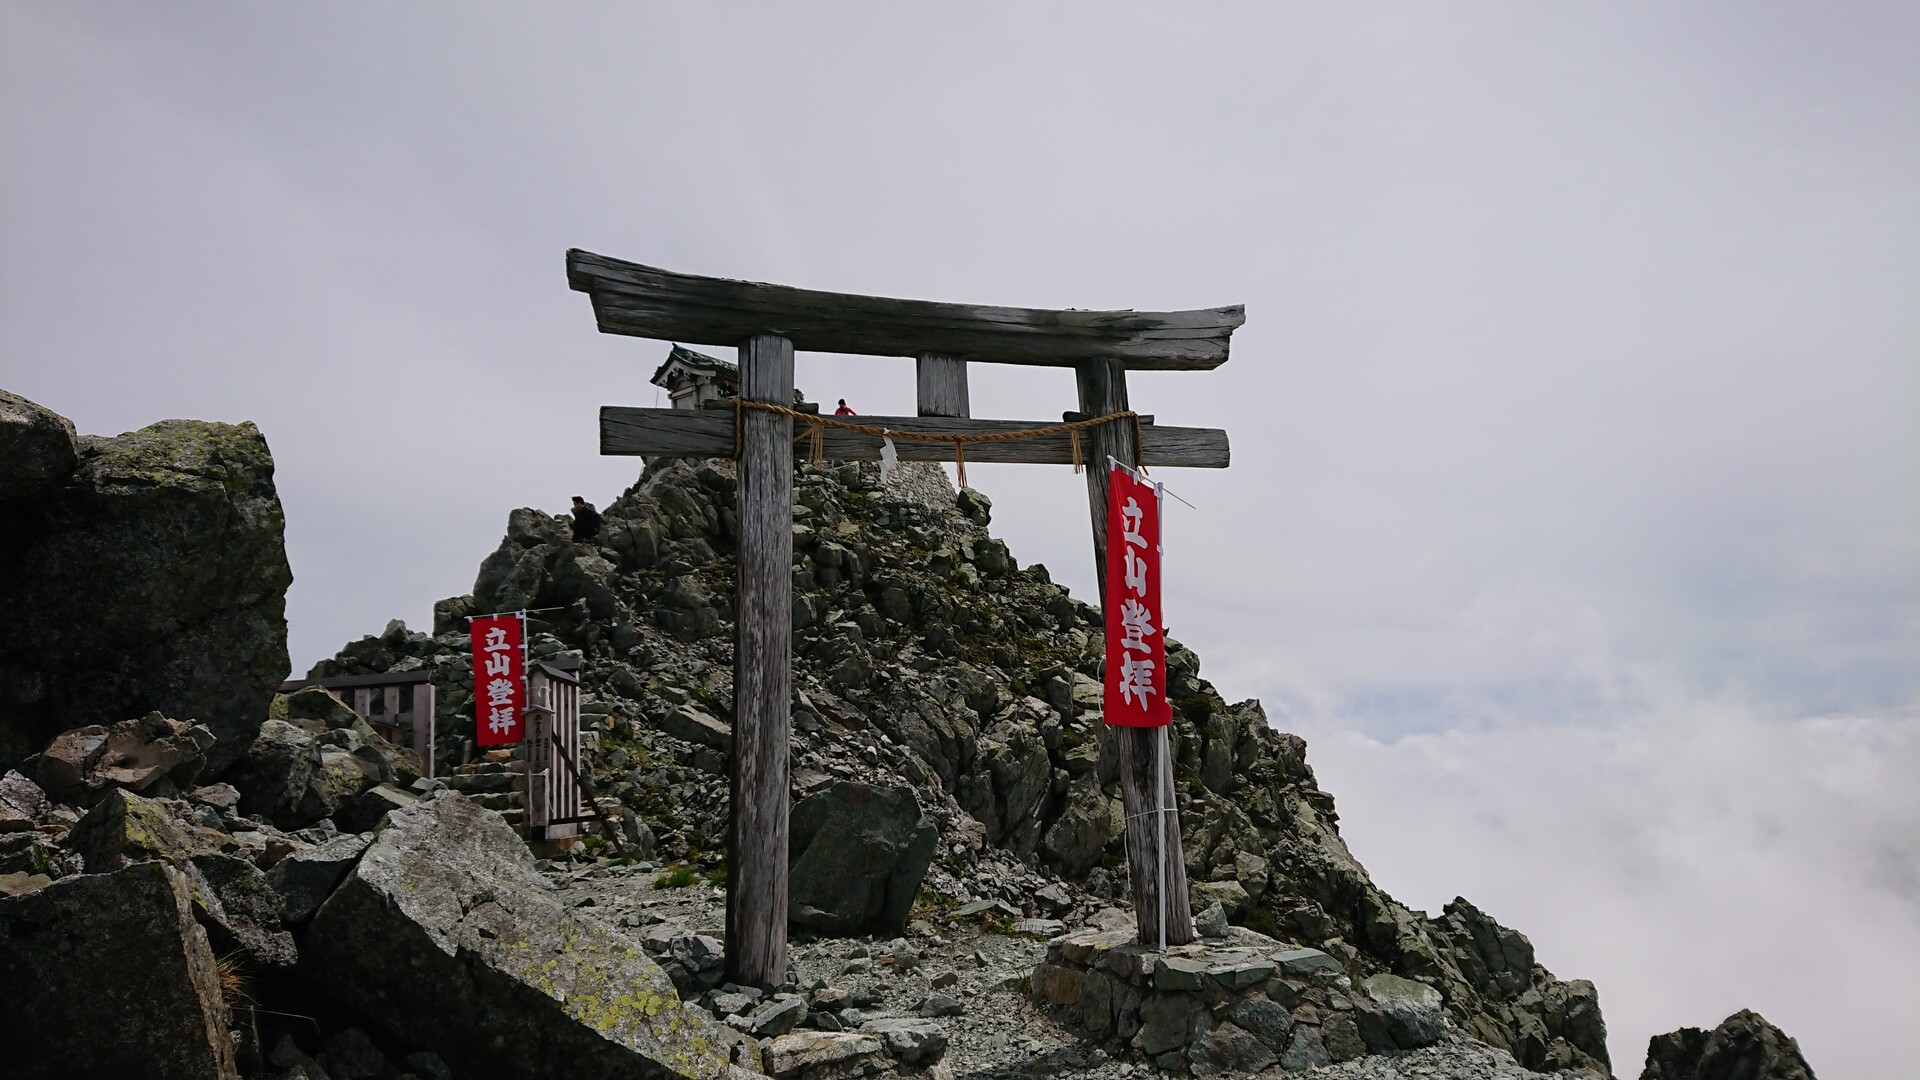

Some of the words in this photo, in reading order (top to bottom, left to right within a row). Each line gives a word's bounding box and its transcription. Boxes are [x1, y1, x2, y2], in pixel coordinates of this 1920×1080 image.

[483, 627, 517, 736] 立山登拝
[1119, 496, 1157, 712] 立山登拝
